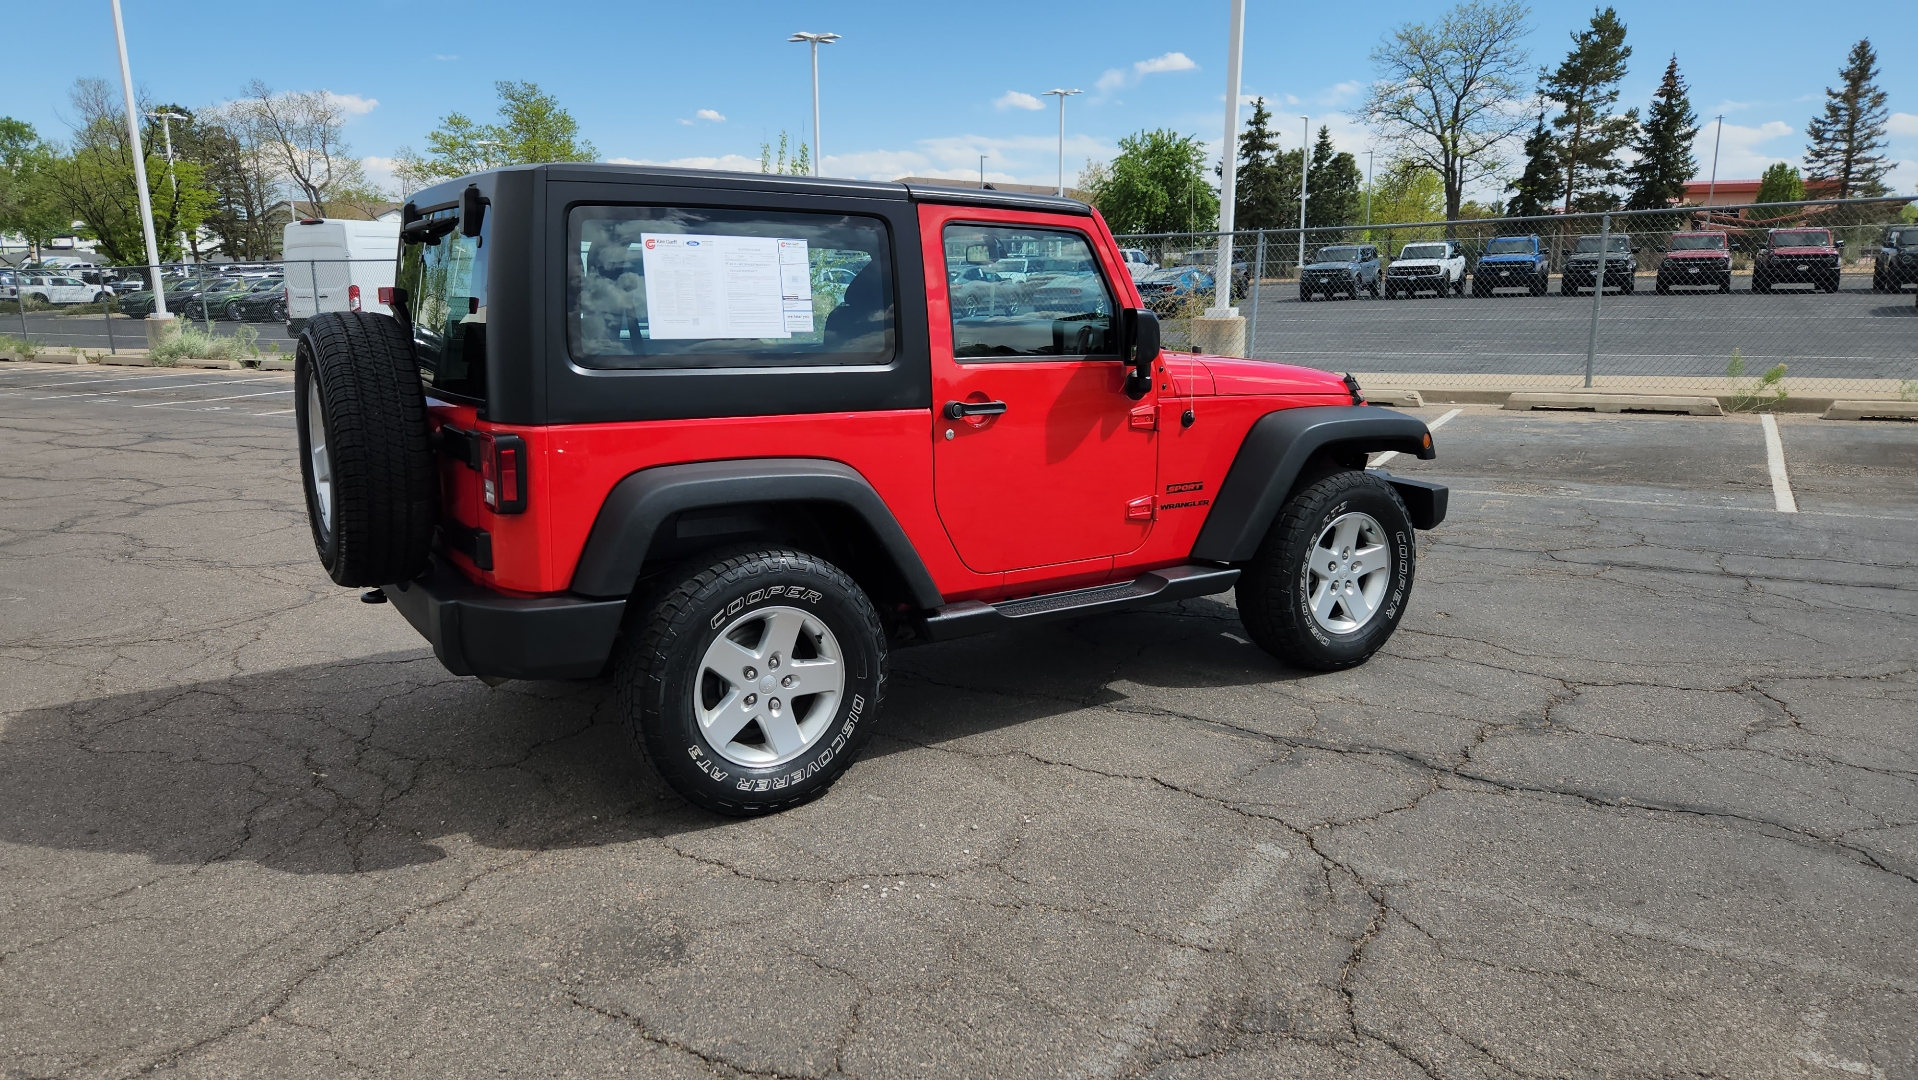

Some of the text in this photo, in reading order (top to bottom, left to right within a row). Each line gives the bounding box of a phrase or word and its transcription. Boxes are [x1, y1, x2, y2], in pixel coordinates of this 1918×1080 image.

[1161, 499, 1209, 510] WRANGLER
[1167, 482, 1203, 493] SPORT
[1386, 531, 1408, 620] COOPER
[710, 585, 823, 630] COOPER
[687, 693, 865, 791] DISCOVERER AT3
